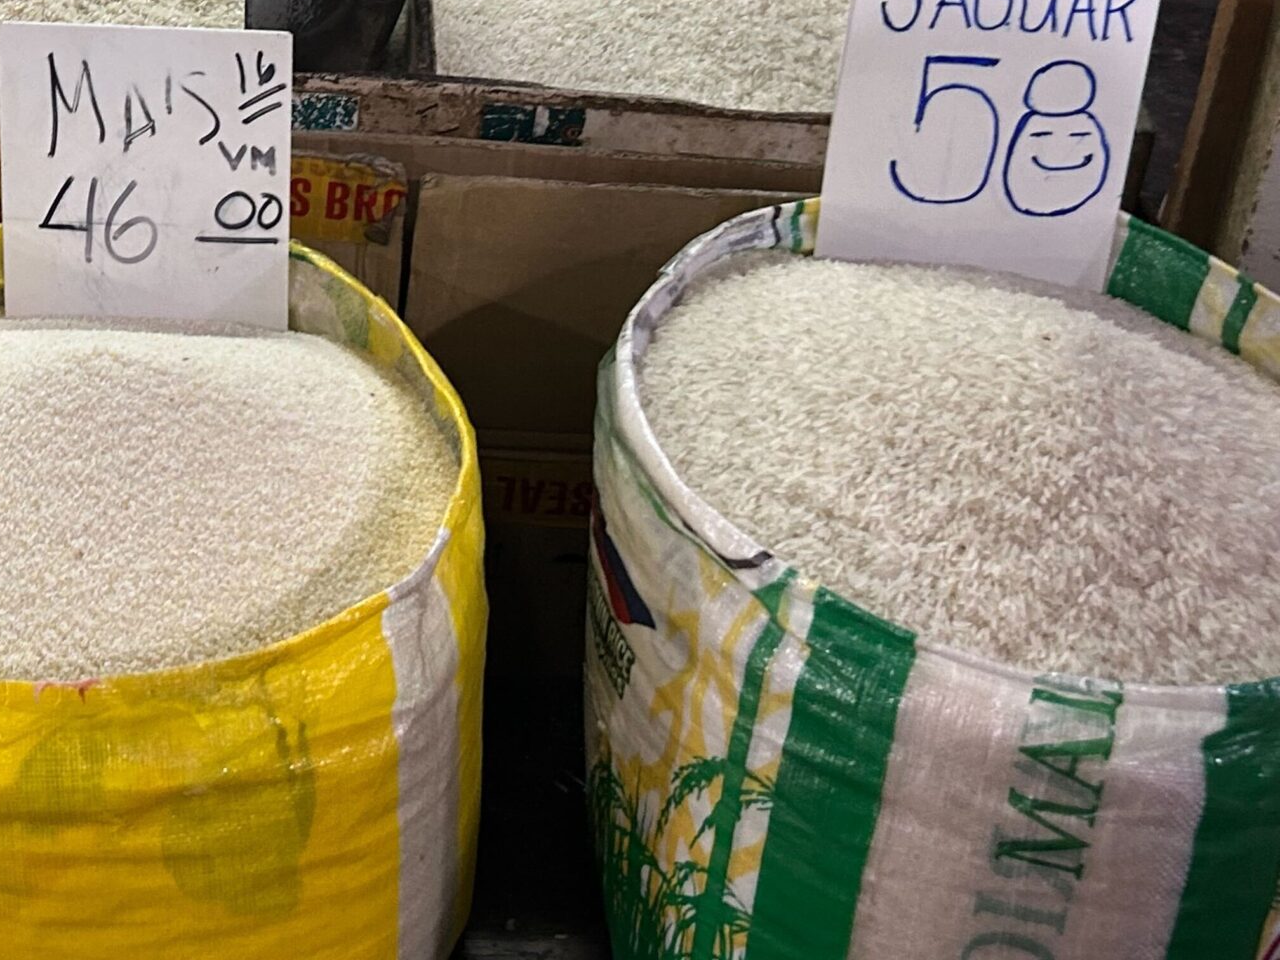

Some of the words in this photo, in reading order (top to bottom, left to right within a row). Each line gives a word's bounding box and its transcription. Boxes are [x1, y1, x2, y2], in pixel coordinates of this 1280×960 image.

[219, 141, 278, 177] VM
[889, 55, 1111, 217] 58
[37, 175, 158, 264] 46
